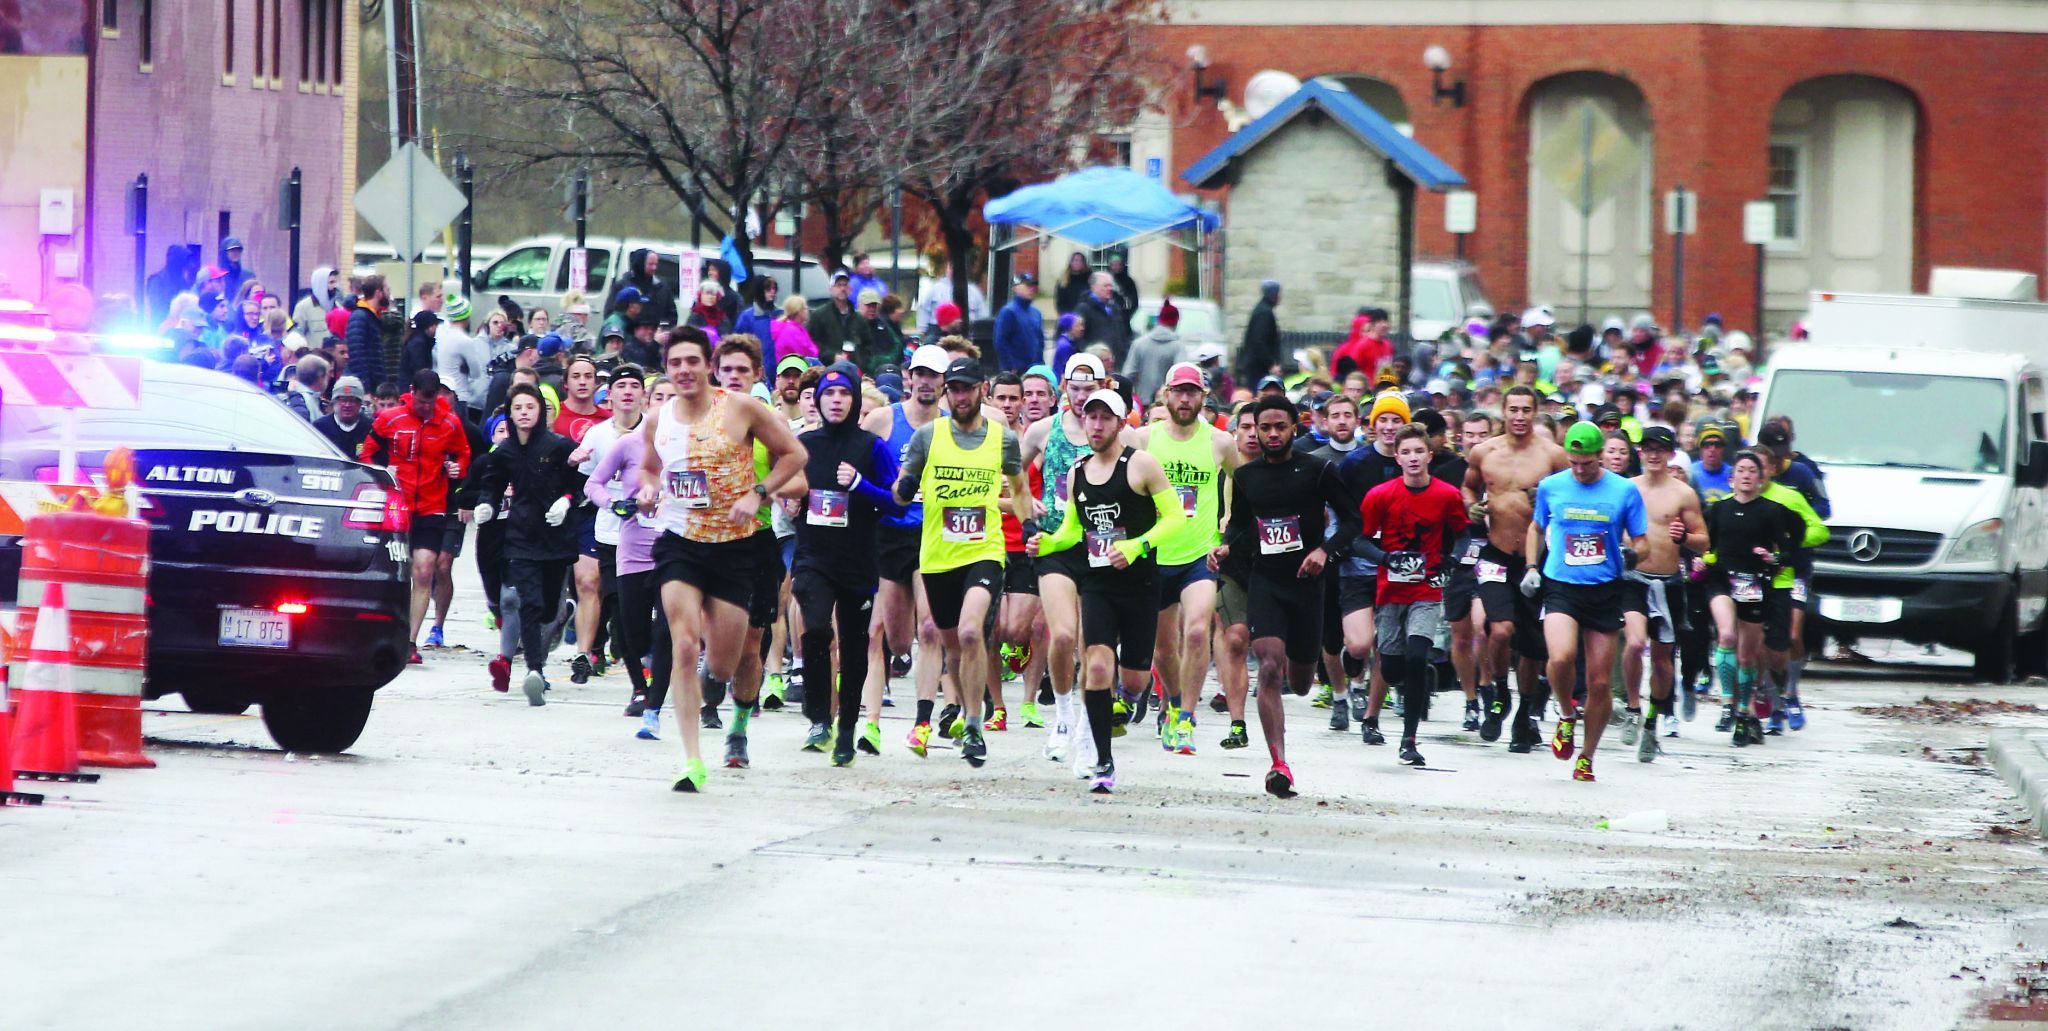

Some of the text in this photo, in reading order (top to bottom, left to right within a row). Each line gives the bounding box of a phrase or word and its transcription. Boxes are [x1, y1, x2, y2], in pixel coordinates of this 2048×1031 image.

[145, 465, 236, 485] ALTON
[301, 474, 344, 491] 911
[936, 468, 991, 482] RUN WELL
[935, 484, 989, 502] Racing
[821, 499, 831, 516] 5
[188, 510, 325, 539] POLICE
[952, 515, 977, 533] 316
[1266, 526, 1291, 544] 326
[385, 540, 408, 563] 194
[1573, 541, 1598, 556] 295
[235, 620, 283, 640] 17 875
